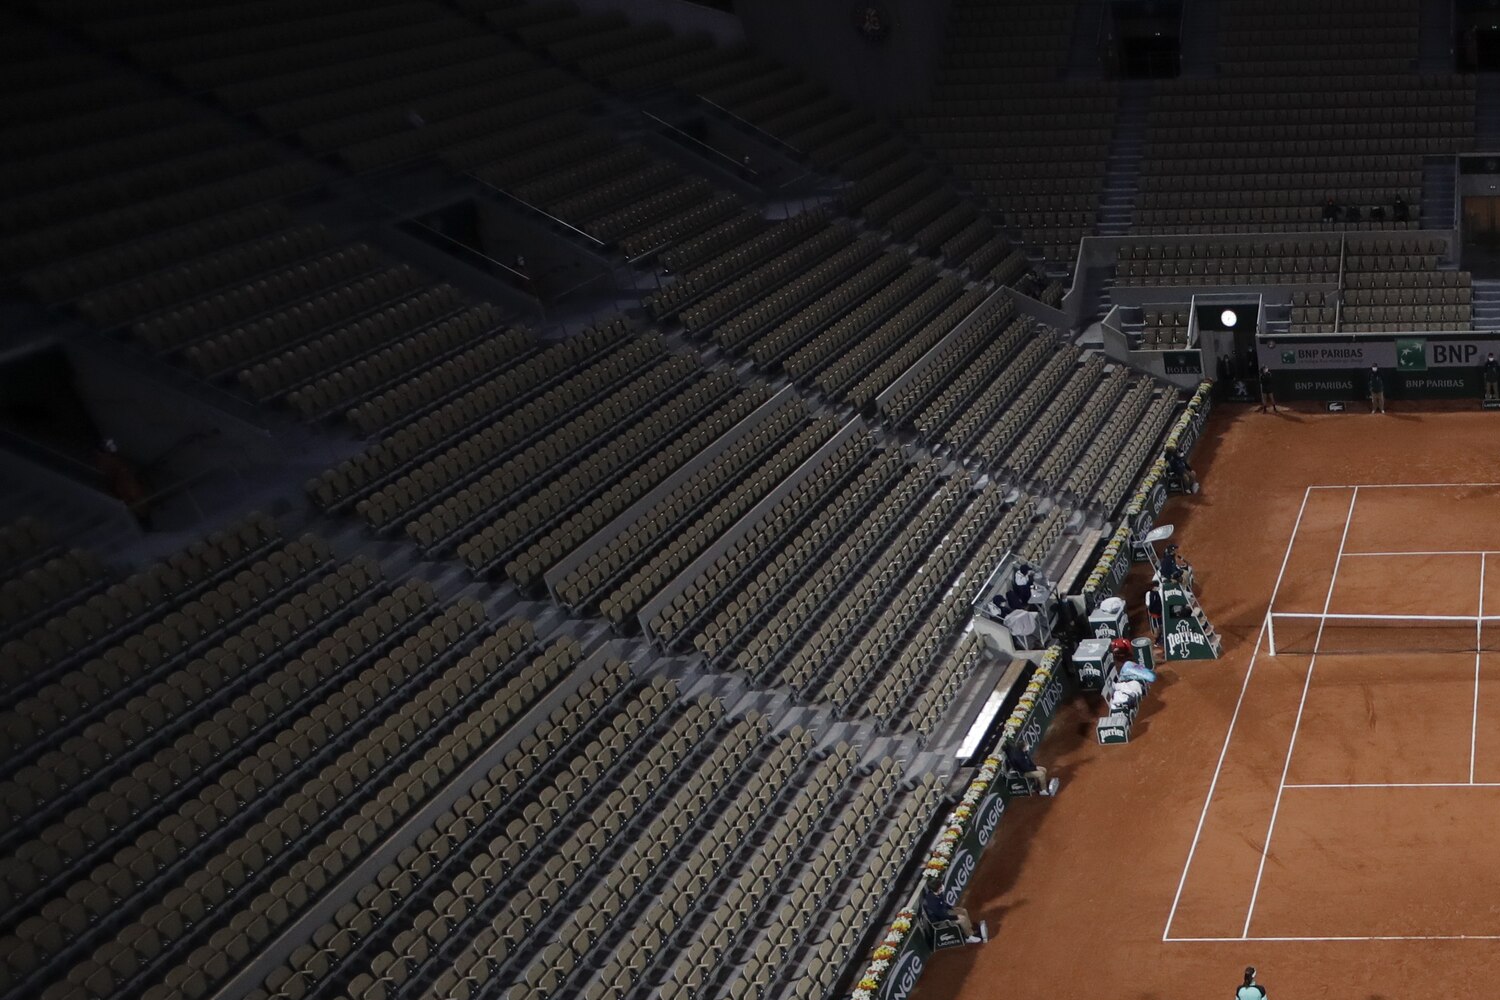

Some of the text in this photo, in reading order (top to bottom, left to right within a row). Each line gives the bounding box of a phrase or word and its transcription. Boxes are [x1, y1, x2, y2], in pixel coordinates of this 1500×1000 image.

[1298, 348, 1363, 358] BNP PARIBAS
[1433, 345, 1477, 363] BNP
[1294, 381, 1353, 390] BNP PARIBAS
[1405, 379, 1465, 388] BNP PARIBAS
